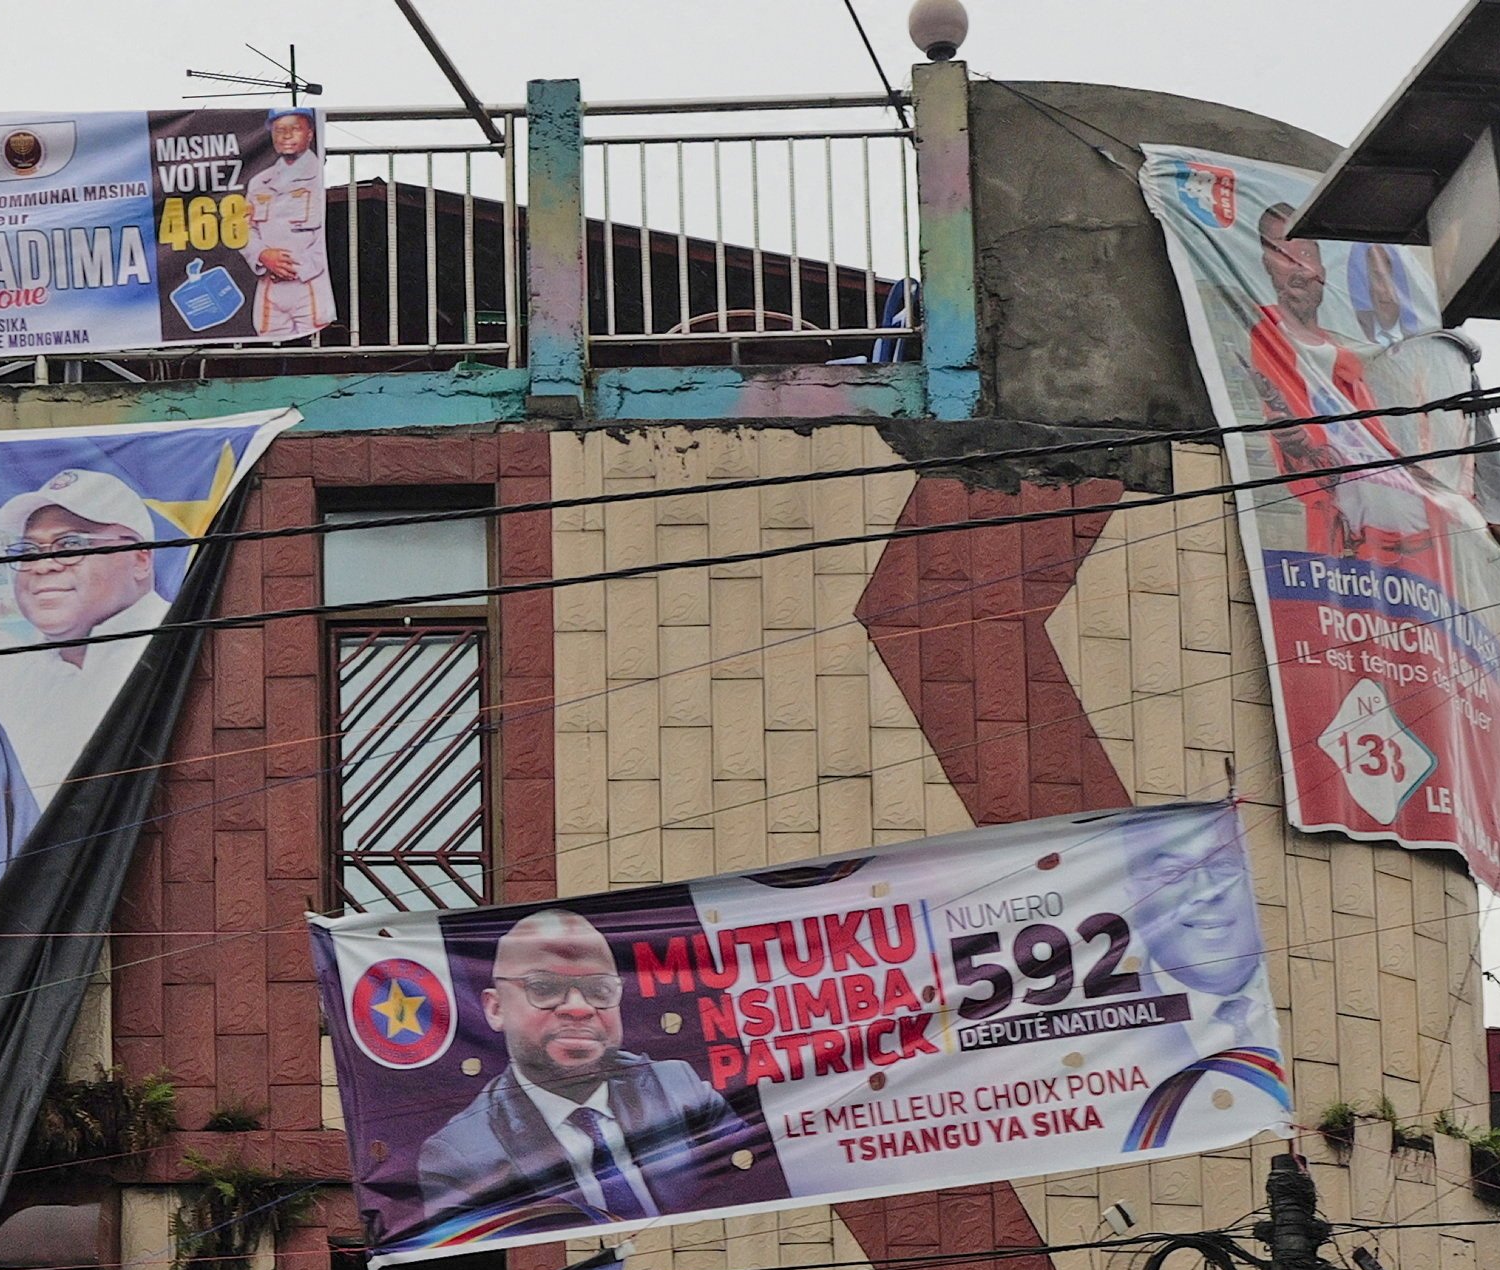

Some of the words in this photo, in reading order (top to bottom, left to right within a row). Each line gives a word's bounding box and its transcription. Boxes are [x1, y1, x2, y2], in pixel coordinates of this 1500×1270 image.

[156, 136, 238, 161] MASINA
[83, 182, 147, 200] MASINA
[160, 162, 243, 191] VOTEZ
[159, 195, 249, 250] 468
[0, 318, 27, 332] SIKA
[8, 330, 89, 348] MBONGWANA
[1282, 559, 1306, 587] Ir.
[1312, 561, 1380, 599] Patrick
[1327, 648, 1354, 672] est
[1362, 651, 1428, 686] temps
[946, 892, 1062, 932] NUMERO
[635, 902, 914, 998] MUTUKU
[950, 912, 1141, 1018] 592
[1048, 1003, 1164, 1038] NATIONAL
[708, 1014, 940, 1090] PATRICK
[784, 1109, 819, 1137] LE
[822, 1091, 966, 1131] MEILLEUR
[970, 1081, 1057, 1115] CHOIX
[1061, 1066, 1149, 1103] PONA
[838, 1125, 981, 1163] TSHANGU
[988, 1117, 1026, 1143] YA
[1033, 1105, 1104, 1137] SIKA
